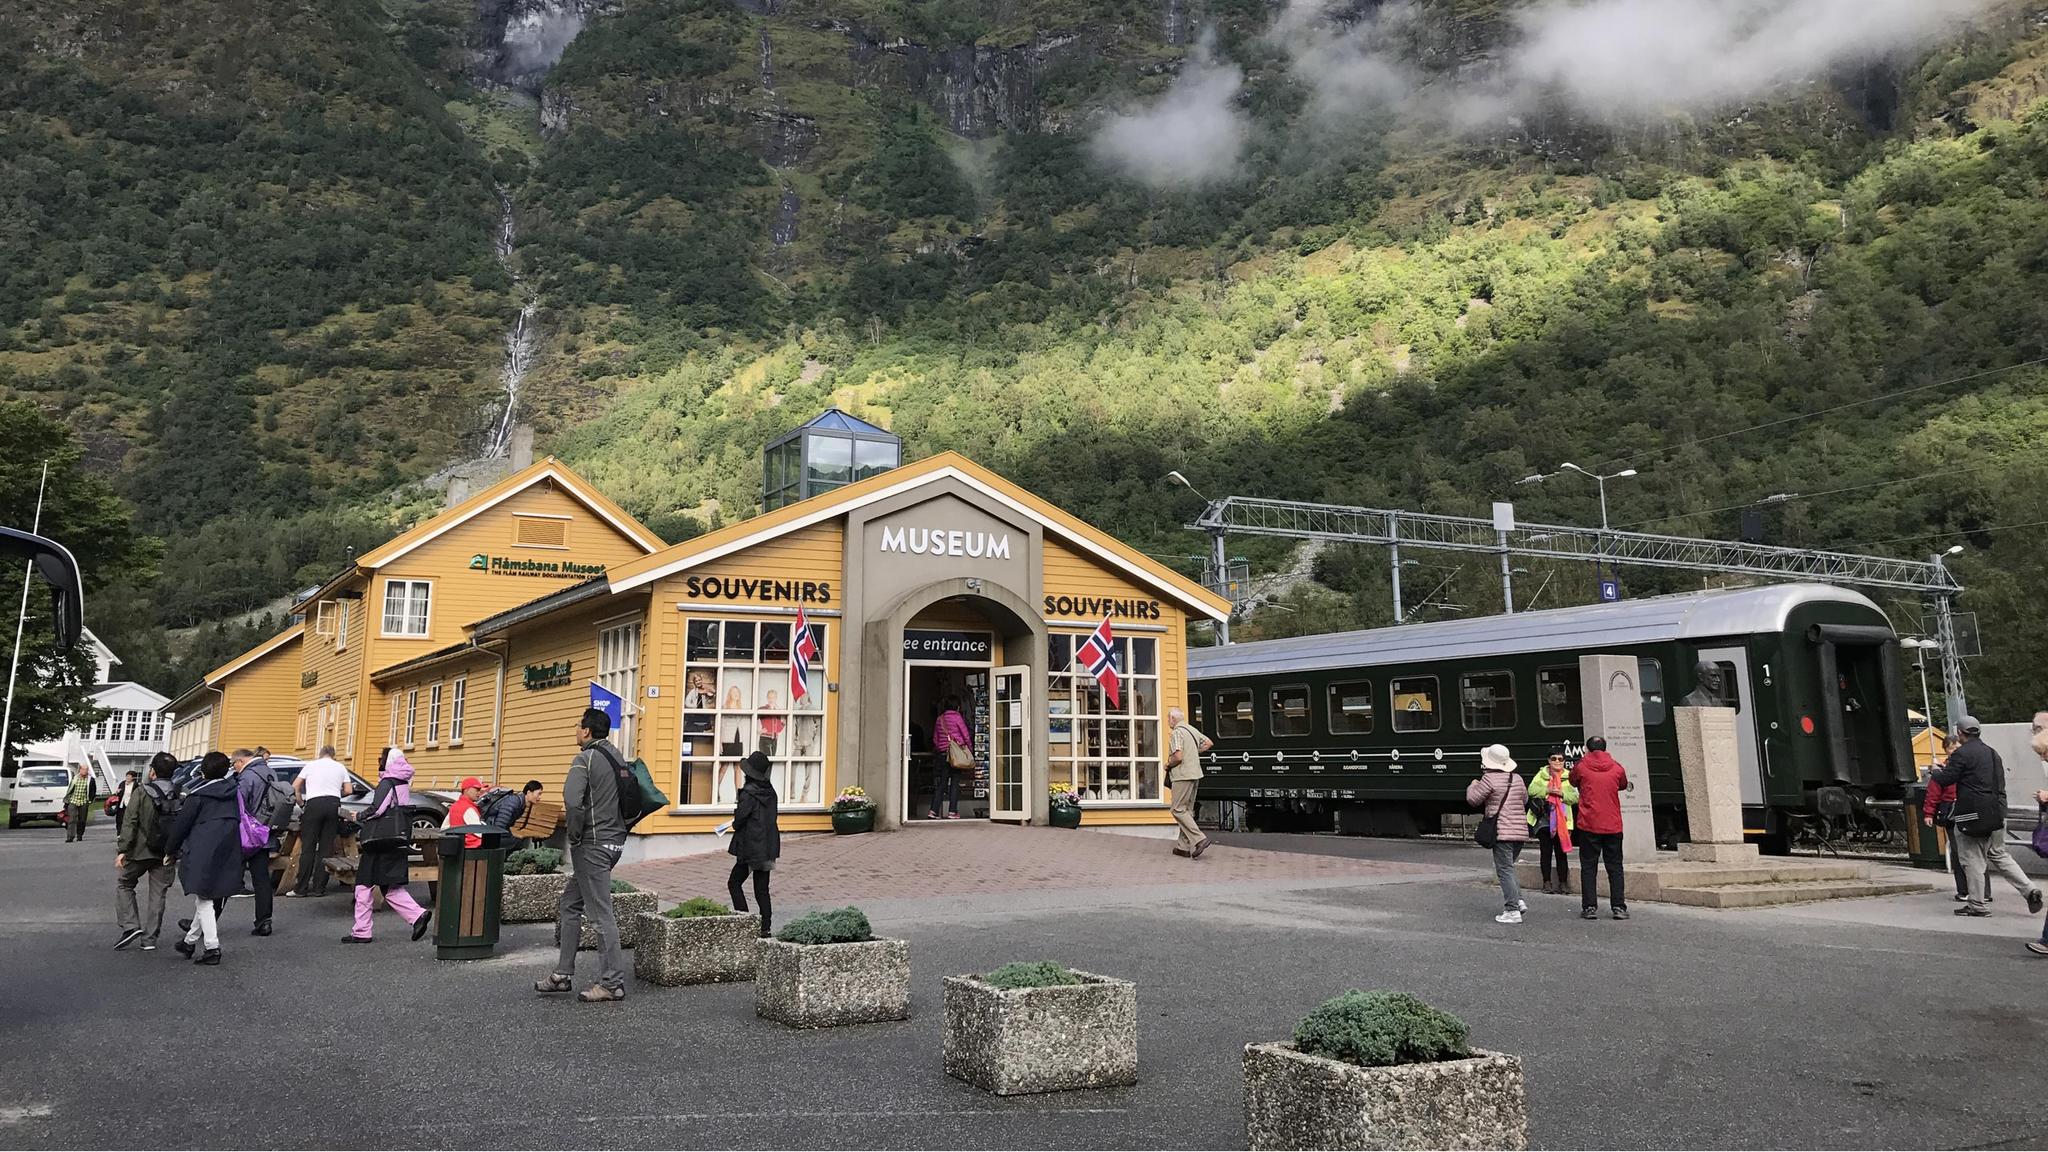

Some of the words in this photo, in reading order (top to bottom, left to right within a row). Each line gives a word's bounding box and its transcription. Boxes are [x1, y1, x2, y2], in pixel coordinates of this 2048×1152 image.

[880, 525, 1010, 560] MUSEUM
[491, 557, 559, 572] Flåmsbana
[687, 576, 831, 603] SOUVENIRS
[1606, 586, 1613, 597] 4
[1044, 595, 1160, 620] SOUVENIRS
[923, 637, 985, 652] entrance
[1762, 663, 1770, 677] 1
